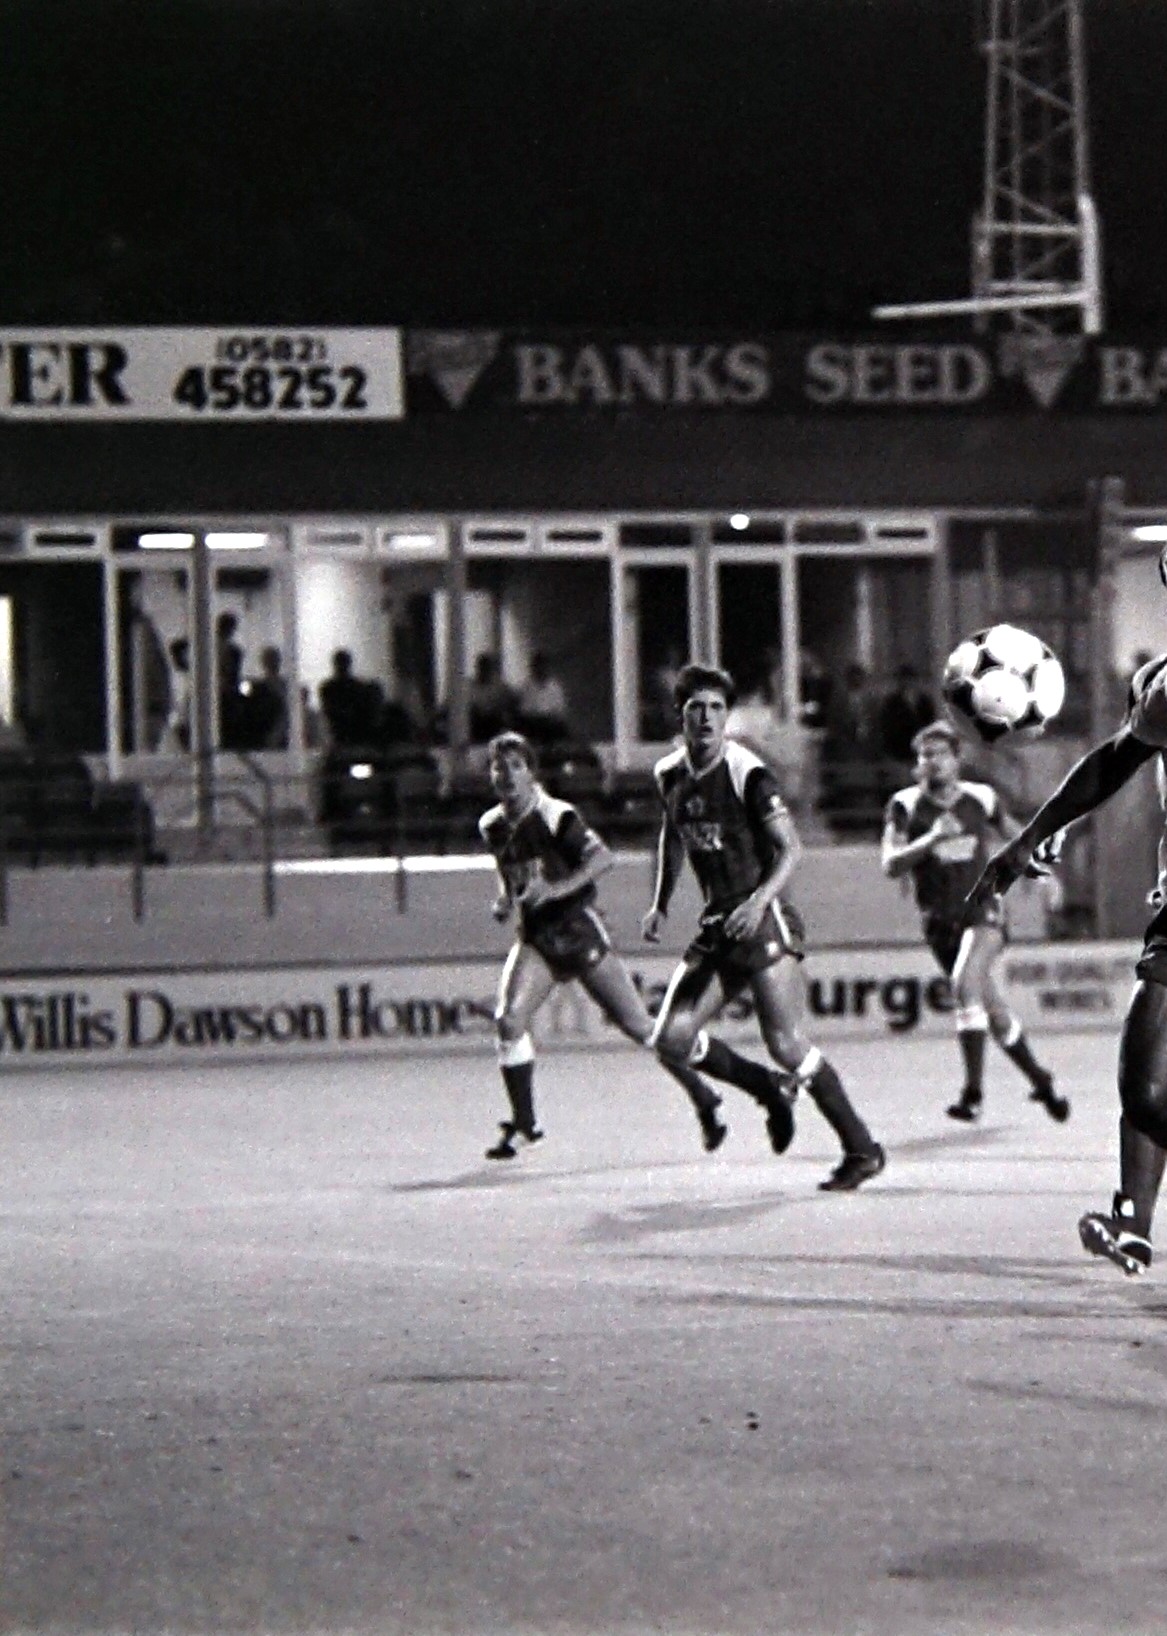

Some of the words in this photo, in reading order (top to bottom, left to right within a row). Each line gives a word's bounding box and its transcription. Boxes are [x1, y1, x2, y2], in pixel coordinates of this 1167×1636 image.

[0, 340, 132, 406] ER
[172, 365, 368, 410] 458252
[516, 343, 770, 402] BANKS
[805, 342, 991, 402] SEED
[126, 987, 327, 1049] Dawson
[807, 970, 957, 1031] urge
